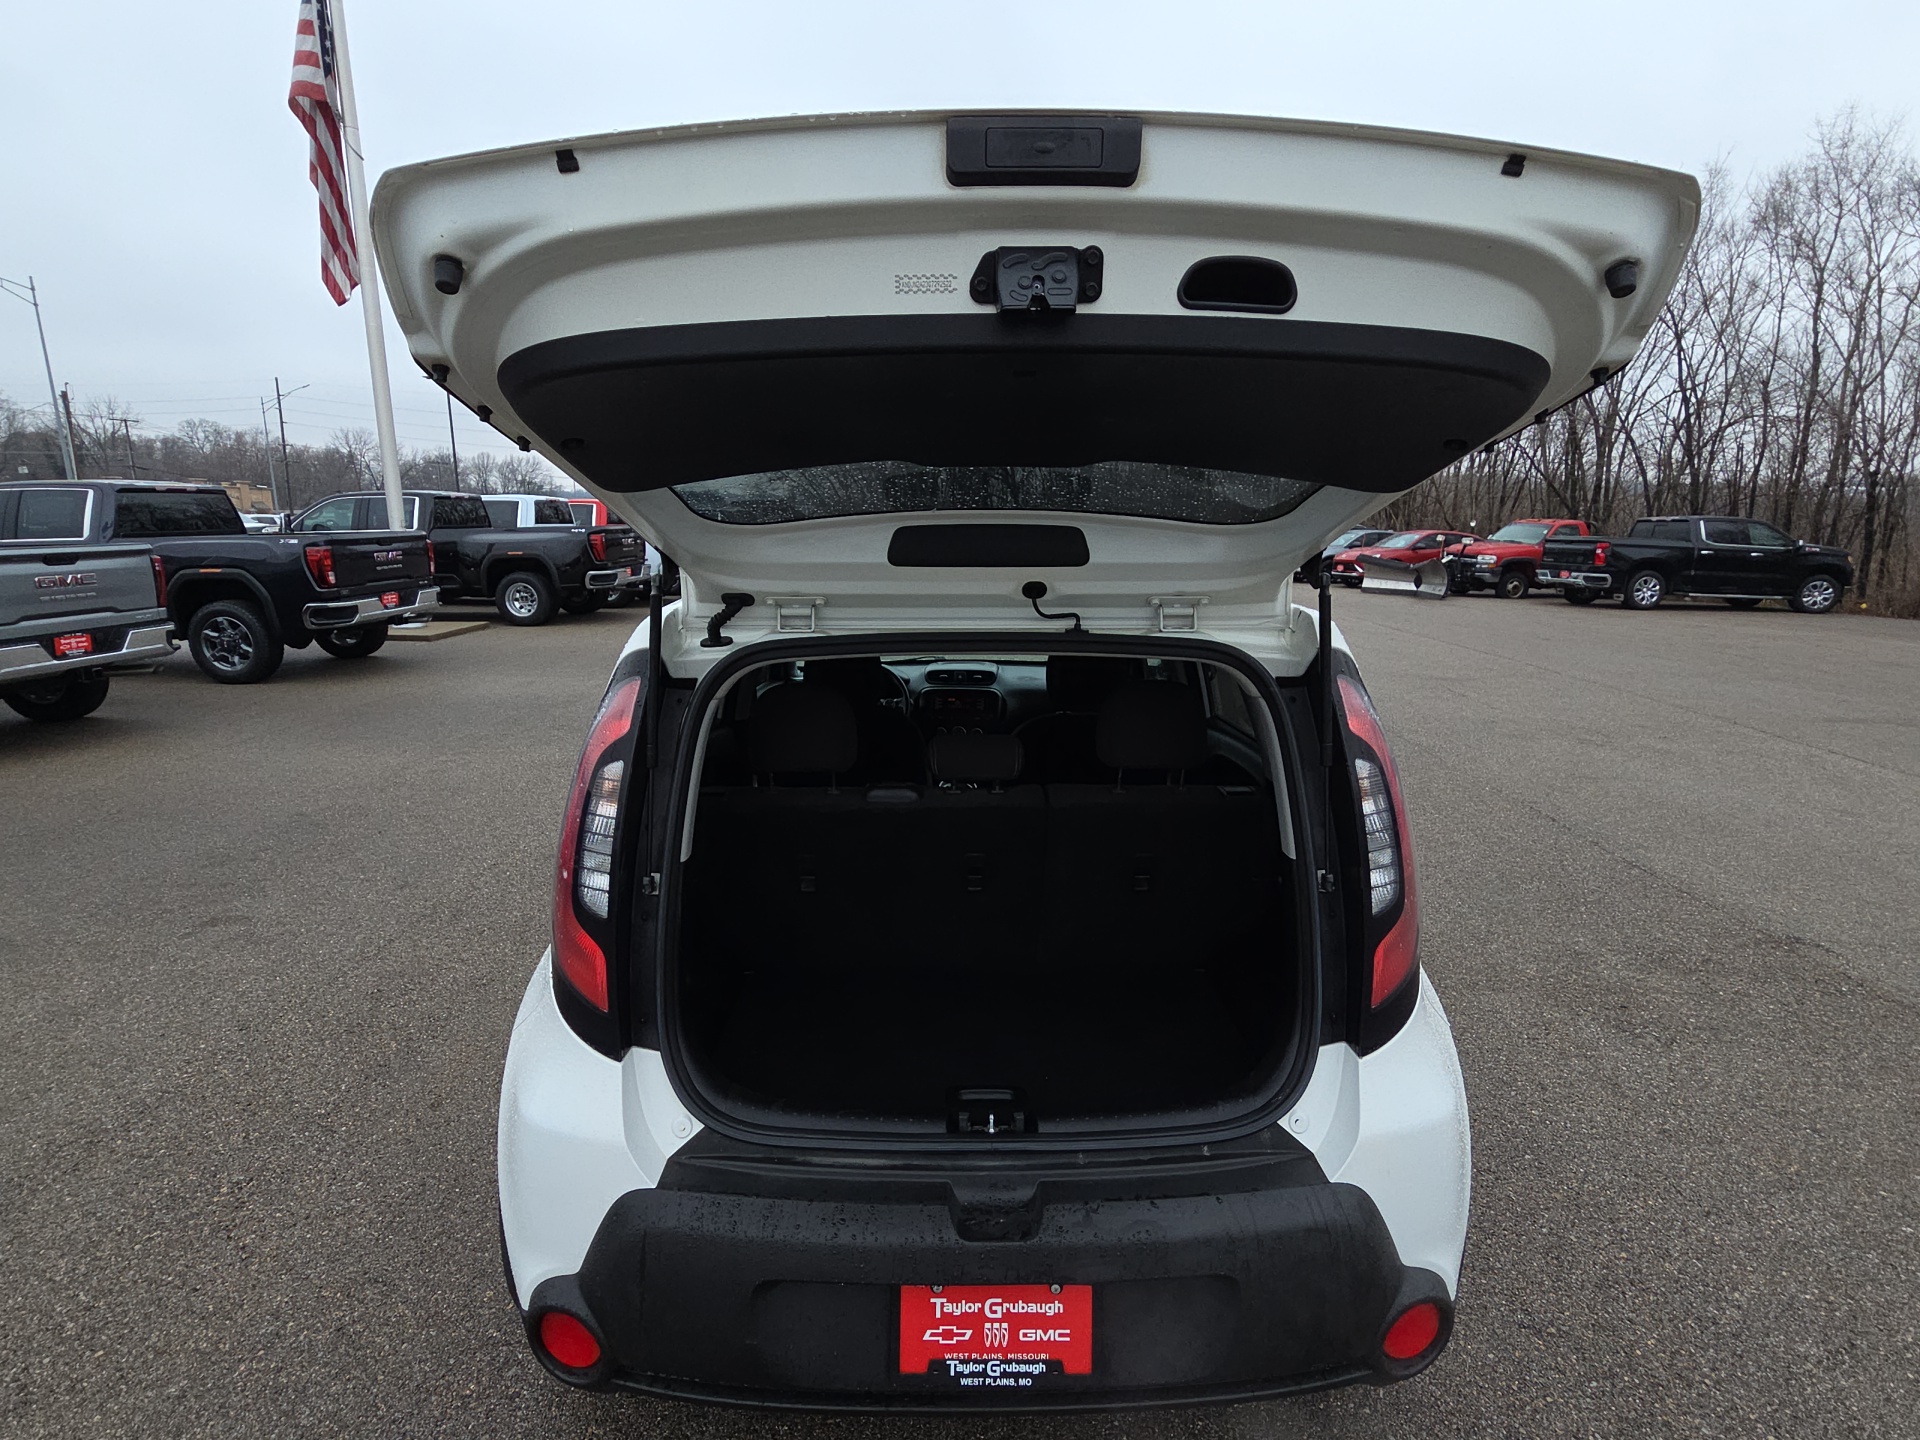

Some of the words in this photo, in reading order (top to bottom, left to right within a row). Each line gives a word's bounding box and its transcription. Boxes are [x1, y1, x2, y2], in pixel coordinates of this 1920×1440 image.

[34, 572, 98, 589] GMC
[929, 1298, 981, 1318] Taylor
[984, 1298, 1064, 1318] Grubaugh
[1019, 1329, 1071, 1341] GMC
[946, 1361, 985, 1376] Taylor
[986, 1361, 1046, 1376] Grubaugh
[960, 1378, 984, 1386] WEST
[985, 1378, 1017, 1387] PLAINS,
[1018, 1378, 1032, 1386] MO
